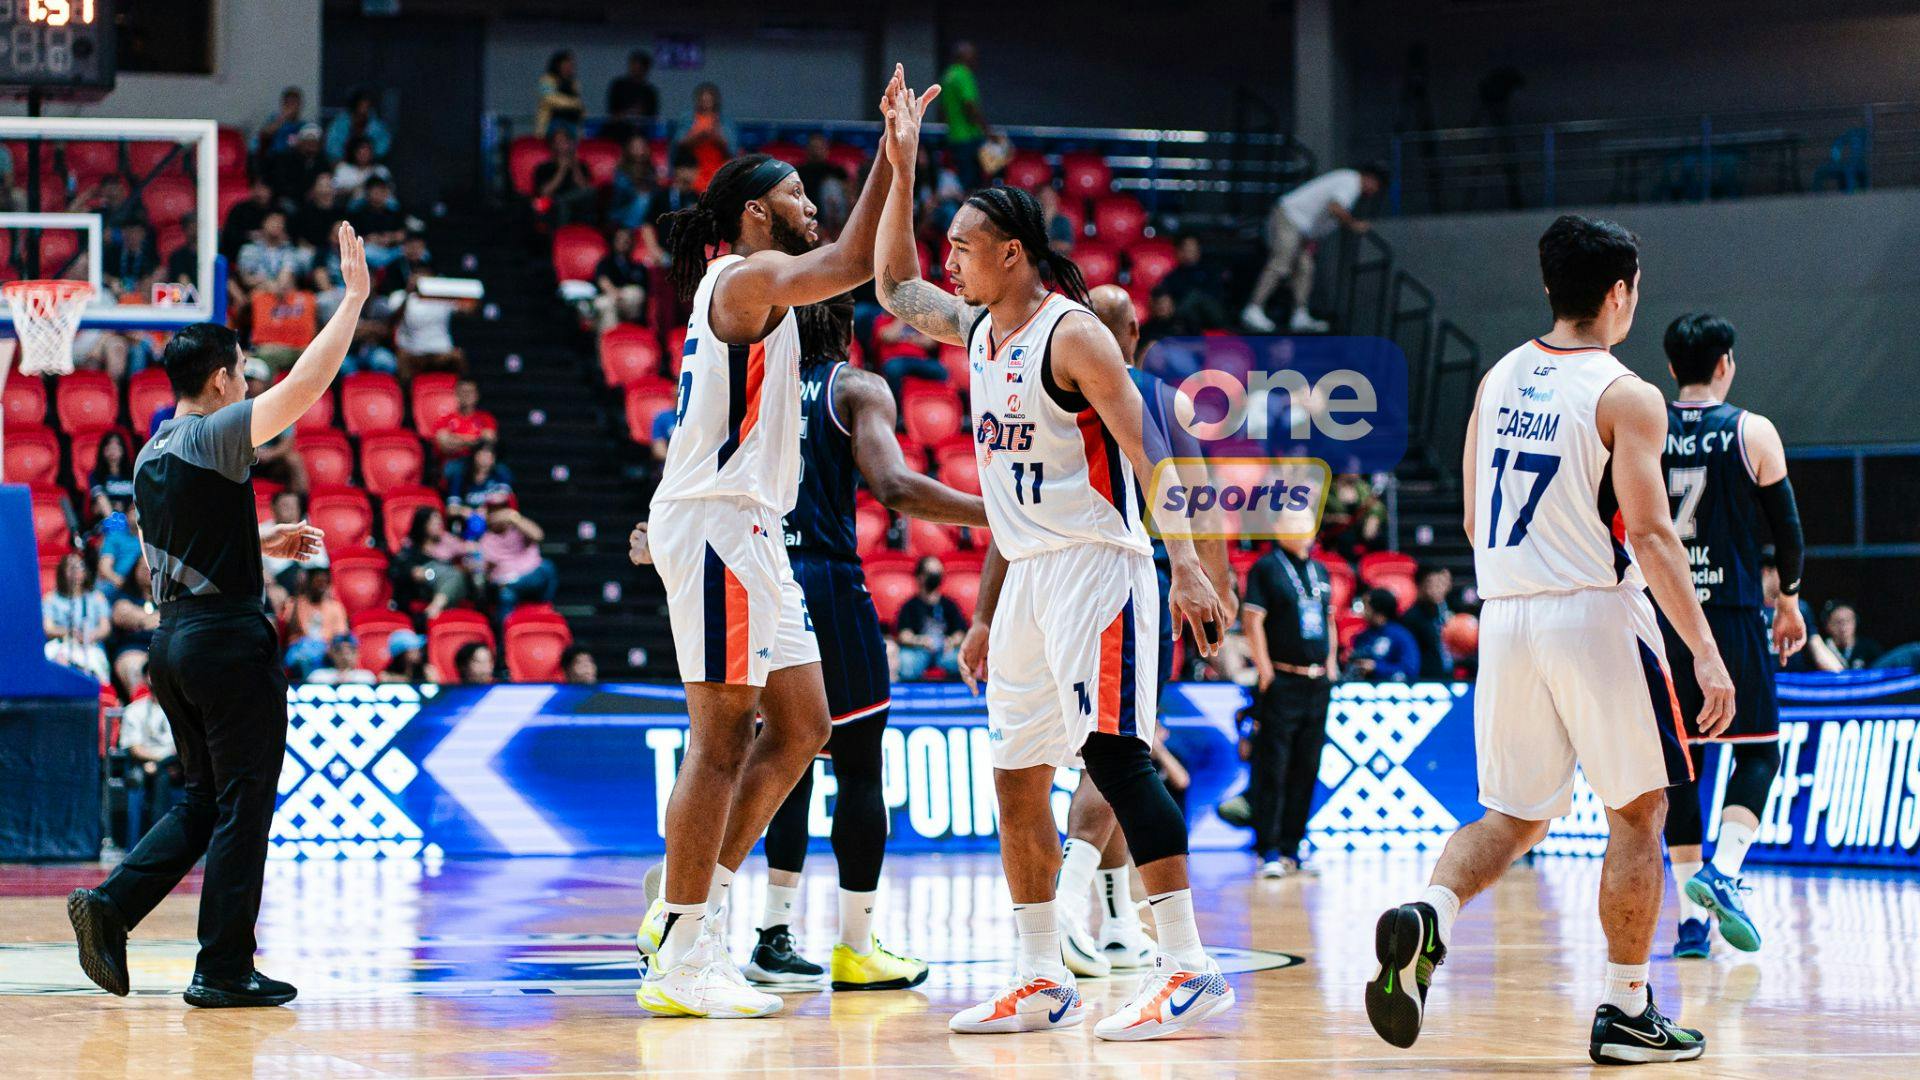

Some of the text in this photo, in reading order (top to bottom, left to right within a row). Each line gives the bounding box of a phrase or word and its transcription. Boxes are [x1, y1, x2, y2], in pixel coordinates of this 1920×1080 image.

[1010, 462, 1044, 505] 11
[1487, 447, 1562, 549] 17
[1669, 465, 1708, 540] 7
